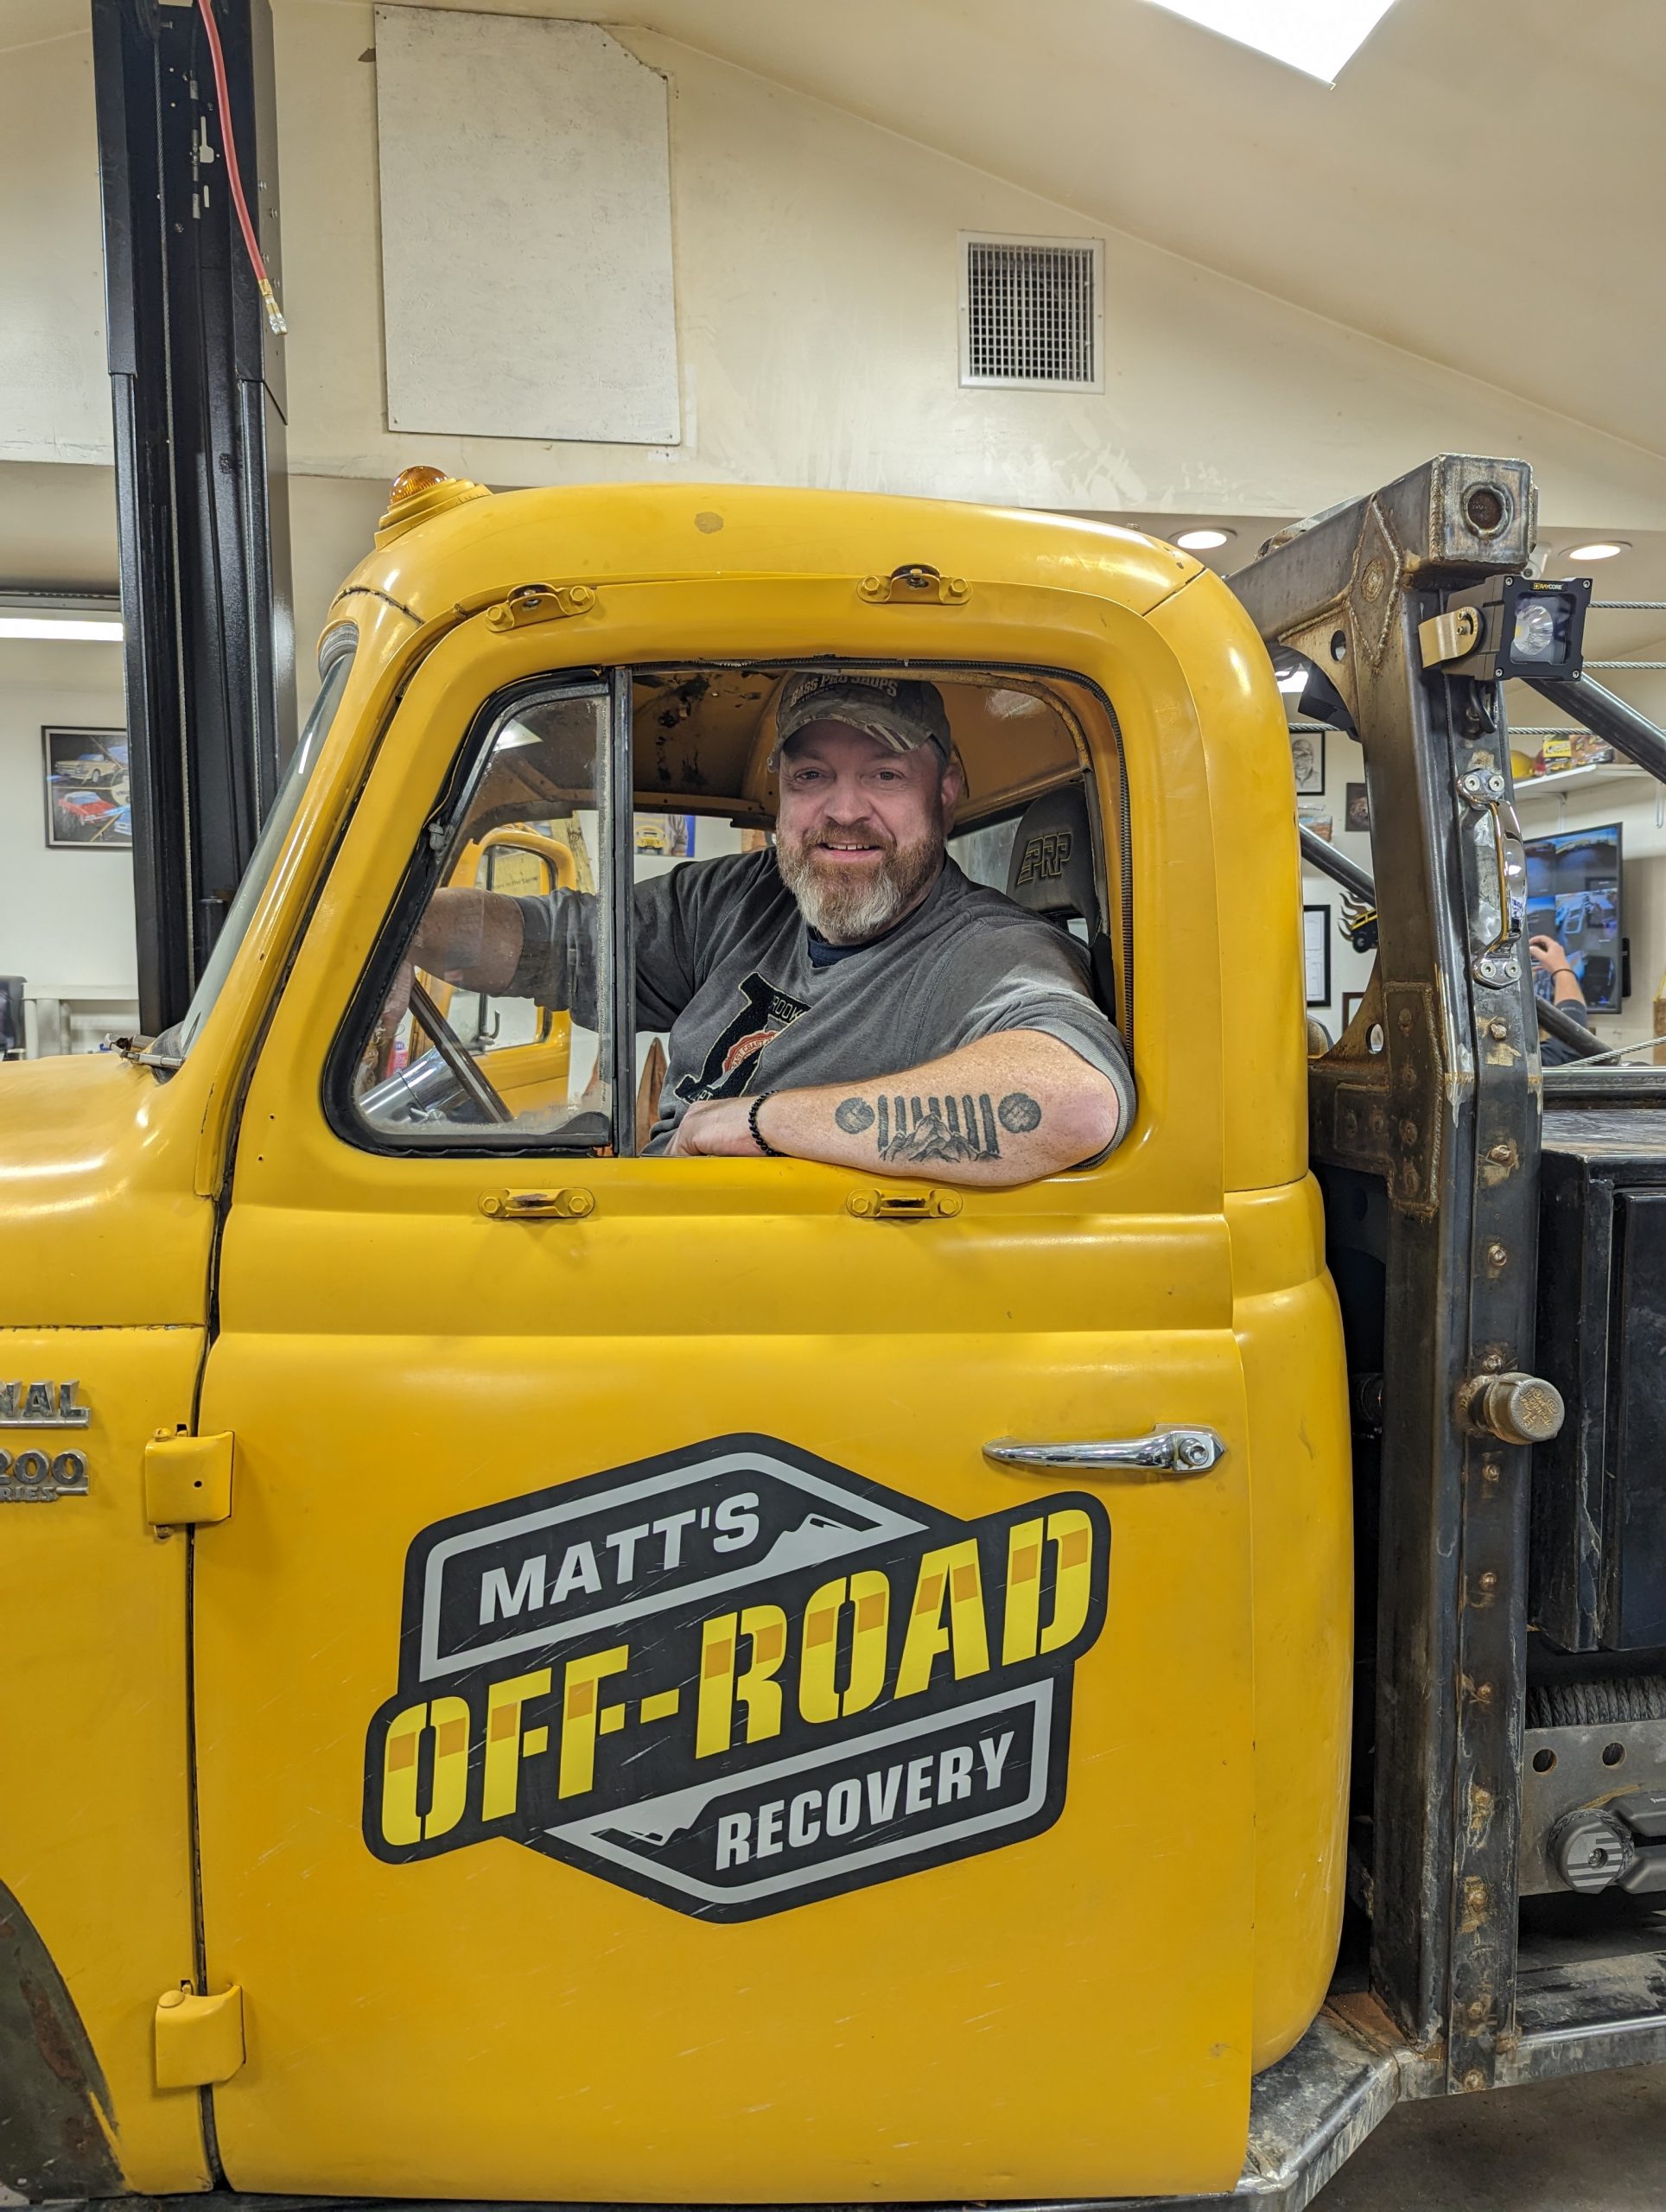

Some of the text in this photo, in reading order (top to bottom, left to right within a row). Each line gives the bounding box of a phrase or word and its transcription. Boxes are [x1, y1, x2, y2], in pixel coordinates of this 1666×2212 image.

[790, 677, 819, 707] BASS
[819, 674, 848, 687] PRO
[850, 675, 898, 697] SHOPS
[1017, 831, 1072, 886] PRP
[479, 1492, 760, 1625] MATT'S
[381, 1510, 1092, 1846] OFF-ROAD
[715, 1731, 1015, 1871] RECOVERY
